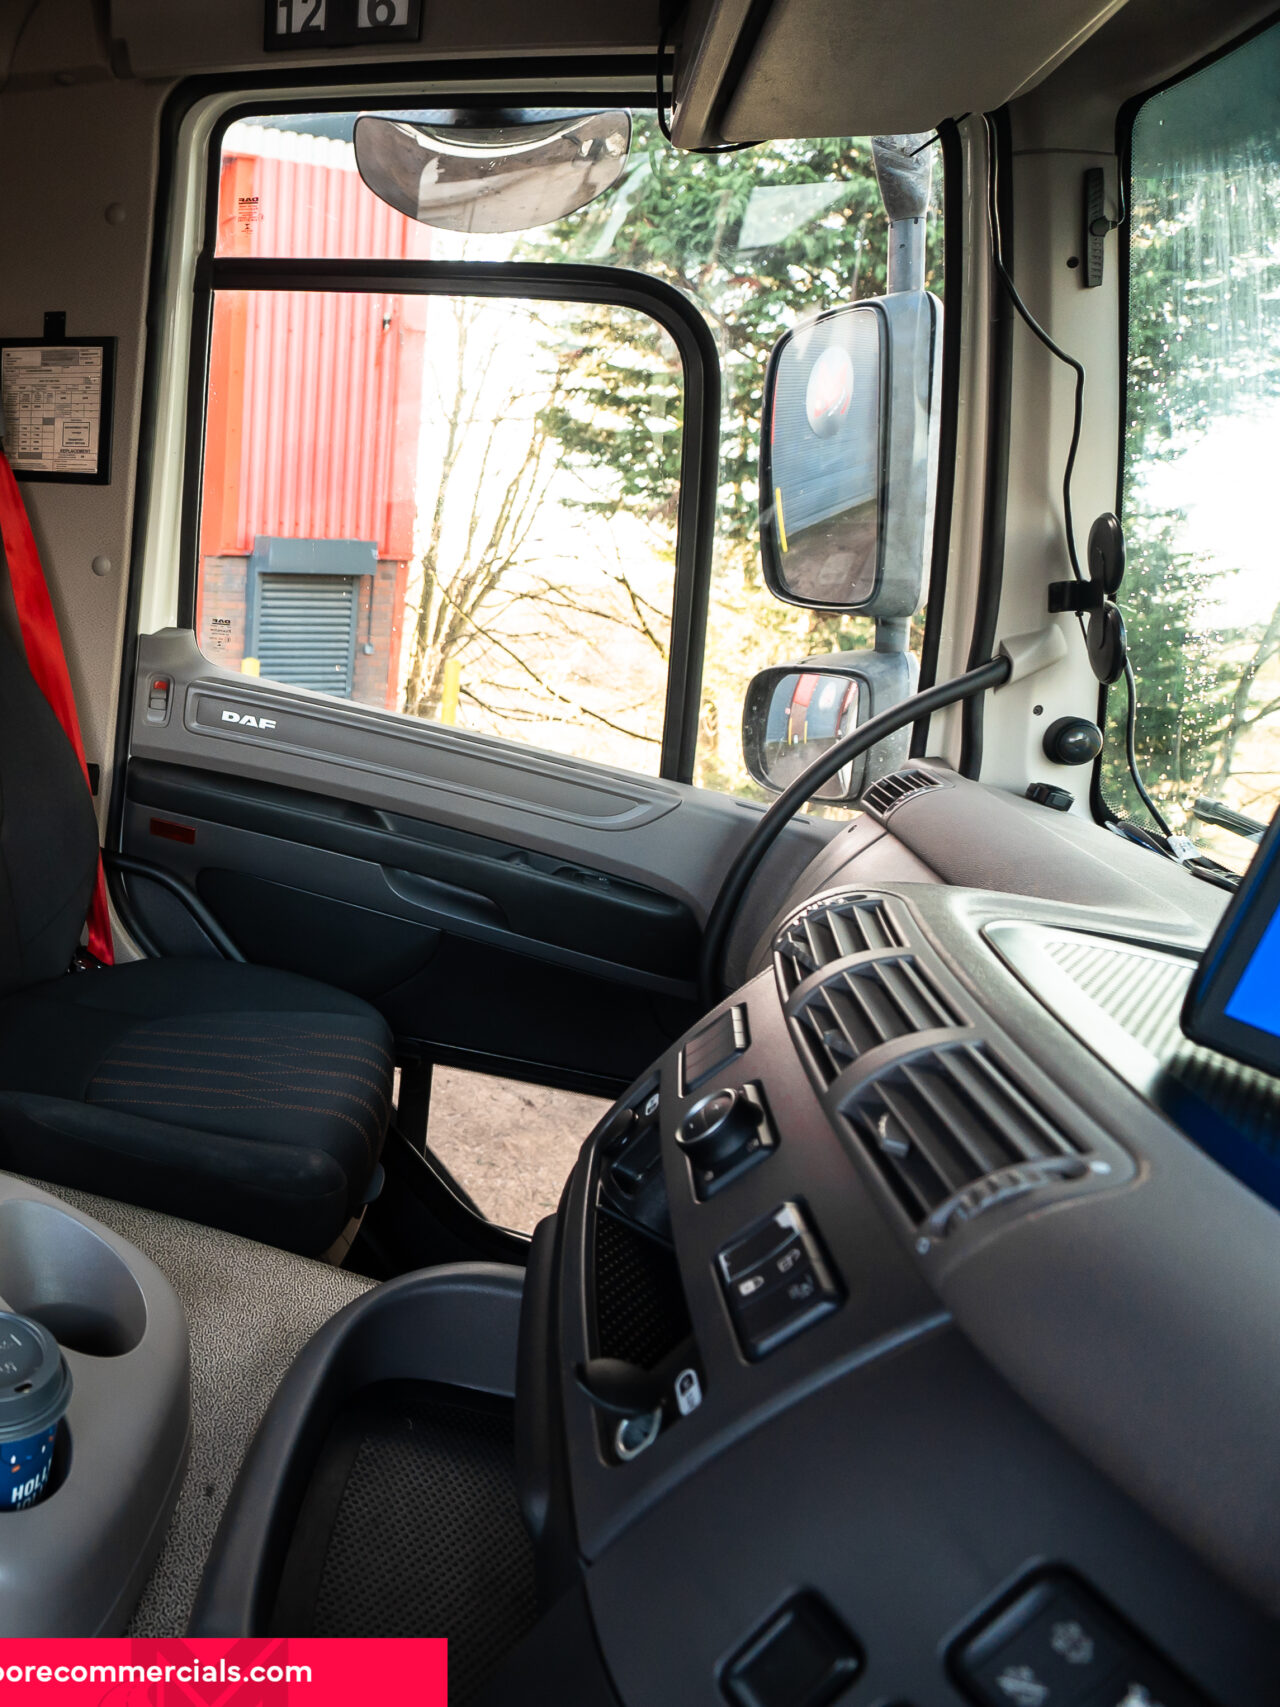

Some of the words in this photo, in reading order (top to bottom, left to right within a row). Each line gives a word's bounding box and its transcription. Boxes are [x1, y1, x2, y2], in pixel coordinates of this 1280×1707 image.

[278, 0, 322, 31] 12
[367, 0, 396, 26] 6
[221, 710, 277, 730] DAF
